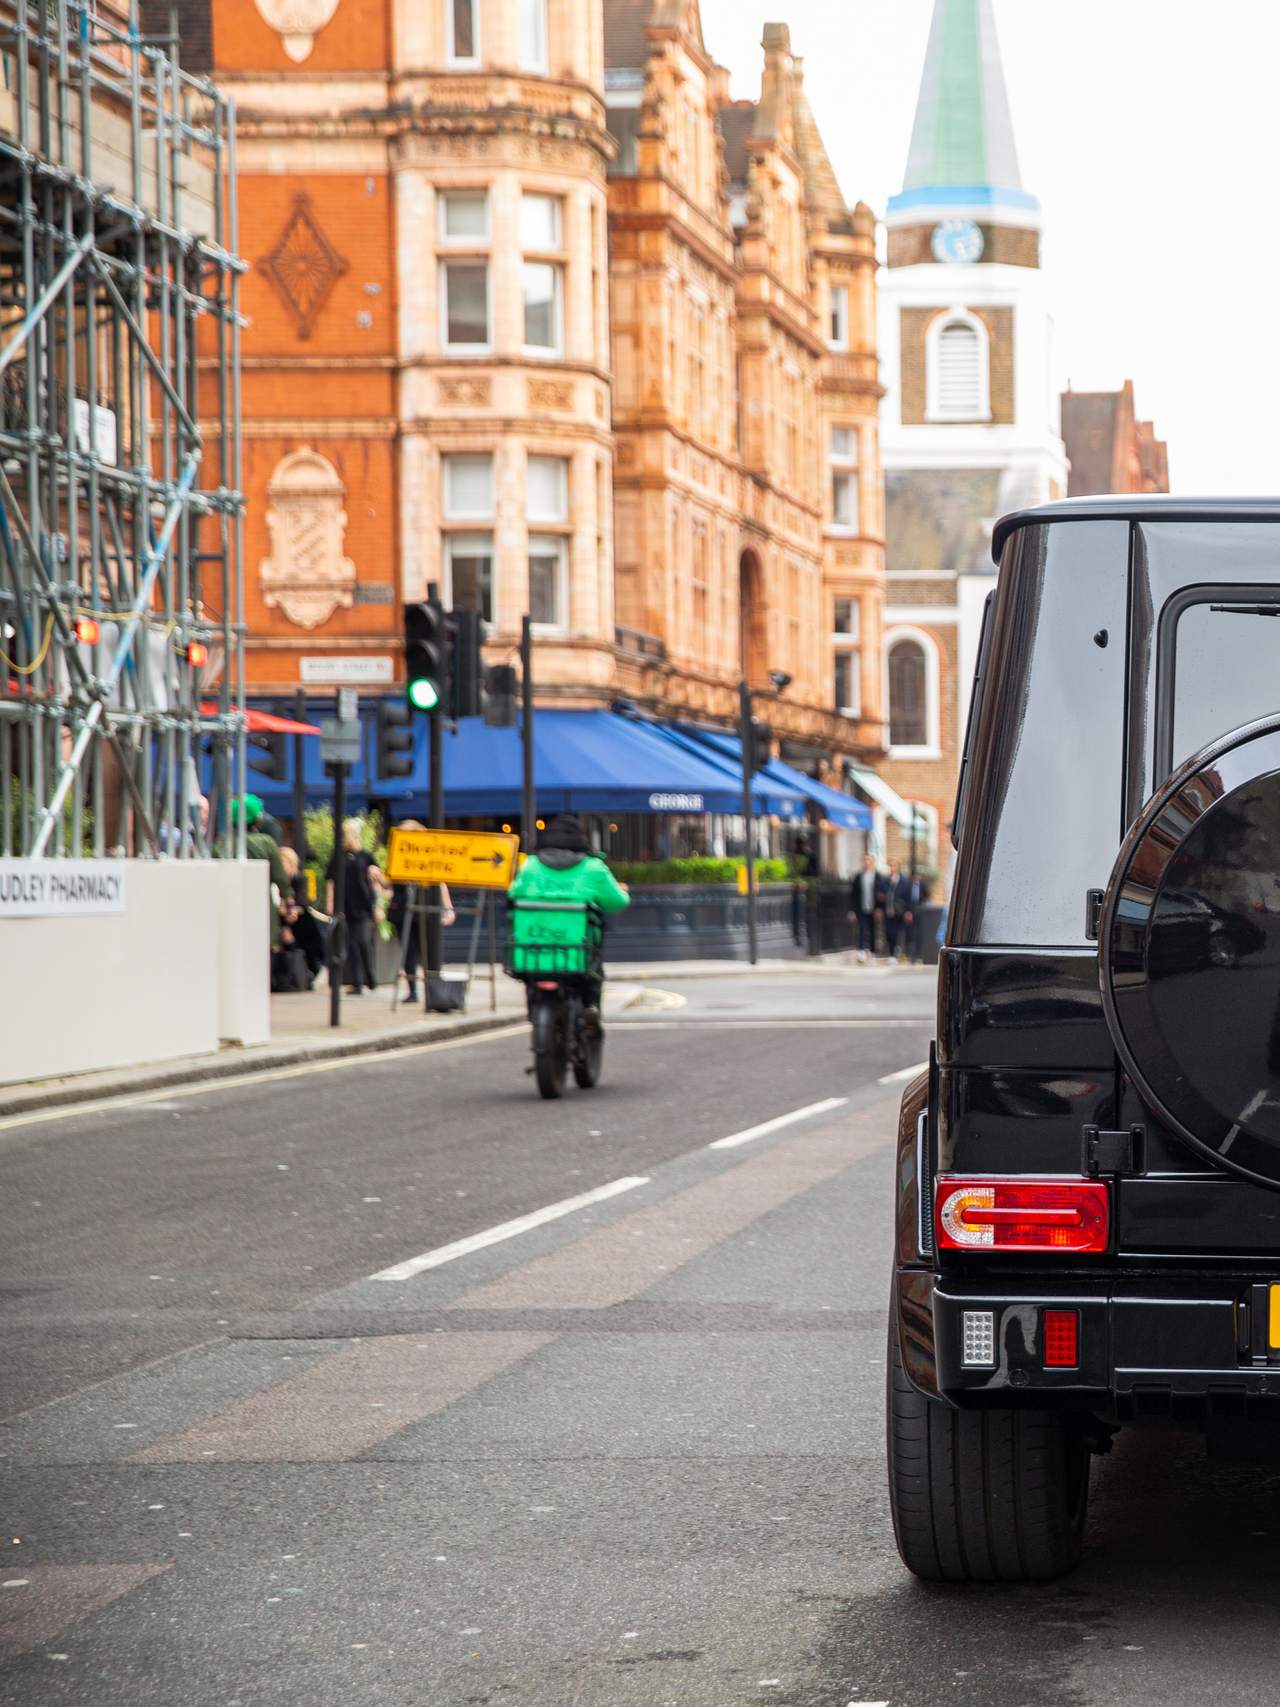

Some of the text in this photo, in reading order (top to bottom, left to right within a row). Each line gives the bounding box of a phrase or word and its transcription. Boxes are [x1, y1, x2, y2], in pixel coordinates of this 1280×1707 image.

[649, 792, 705, 811] GEORGE
[399, 838, 469, 857] Diverted
[51, 872, 122, 902] PHARMACY
